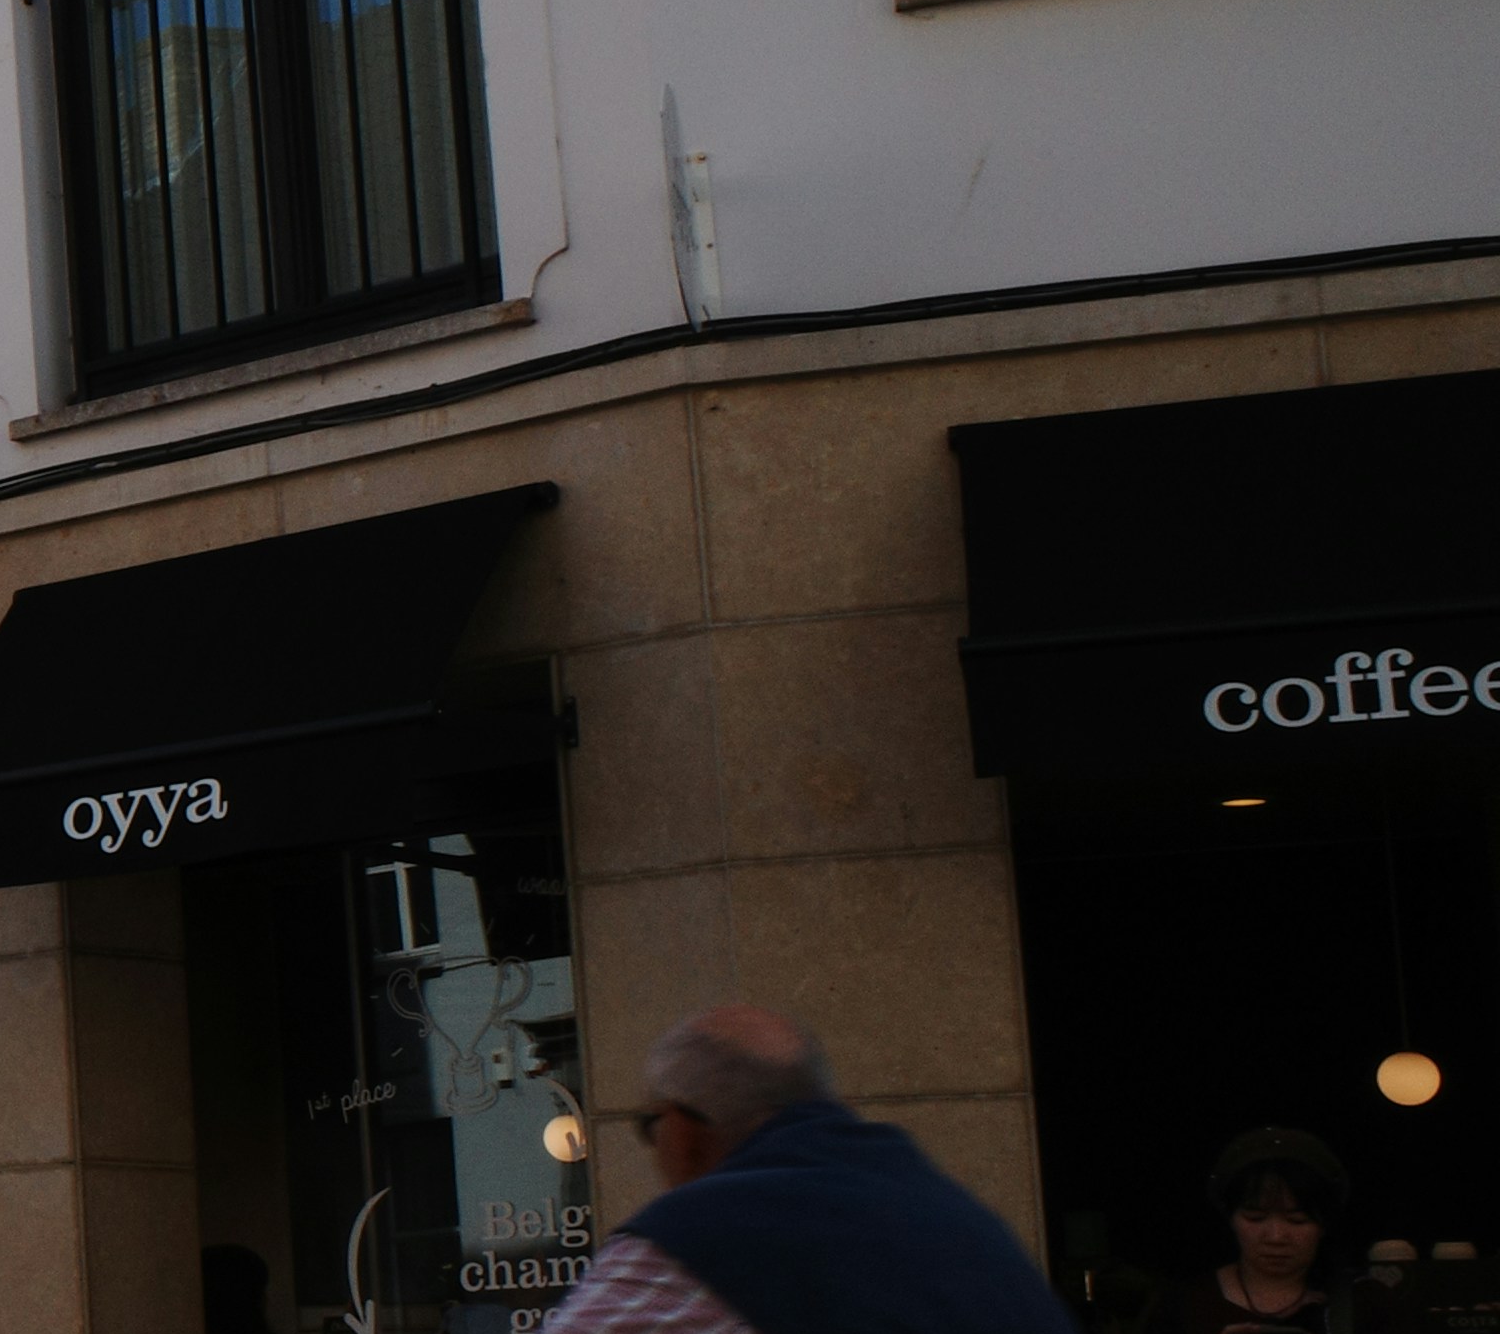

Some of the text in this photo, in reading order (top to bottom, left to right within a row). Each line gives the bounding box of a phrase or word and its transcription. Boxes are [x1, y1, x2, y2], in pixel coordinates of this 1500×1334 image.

[62, 776, 229, 854] oyya
[340, 1079, 396, 1124] place
[480, 1197, 592, 1248] Belg
